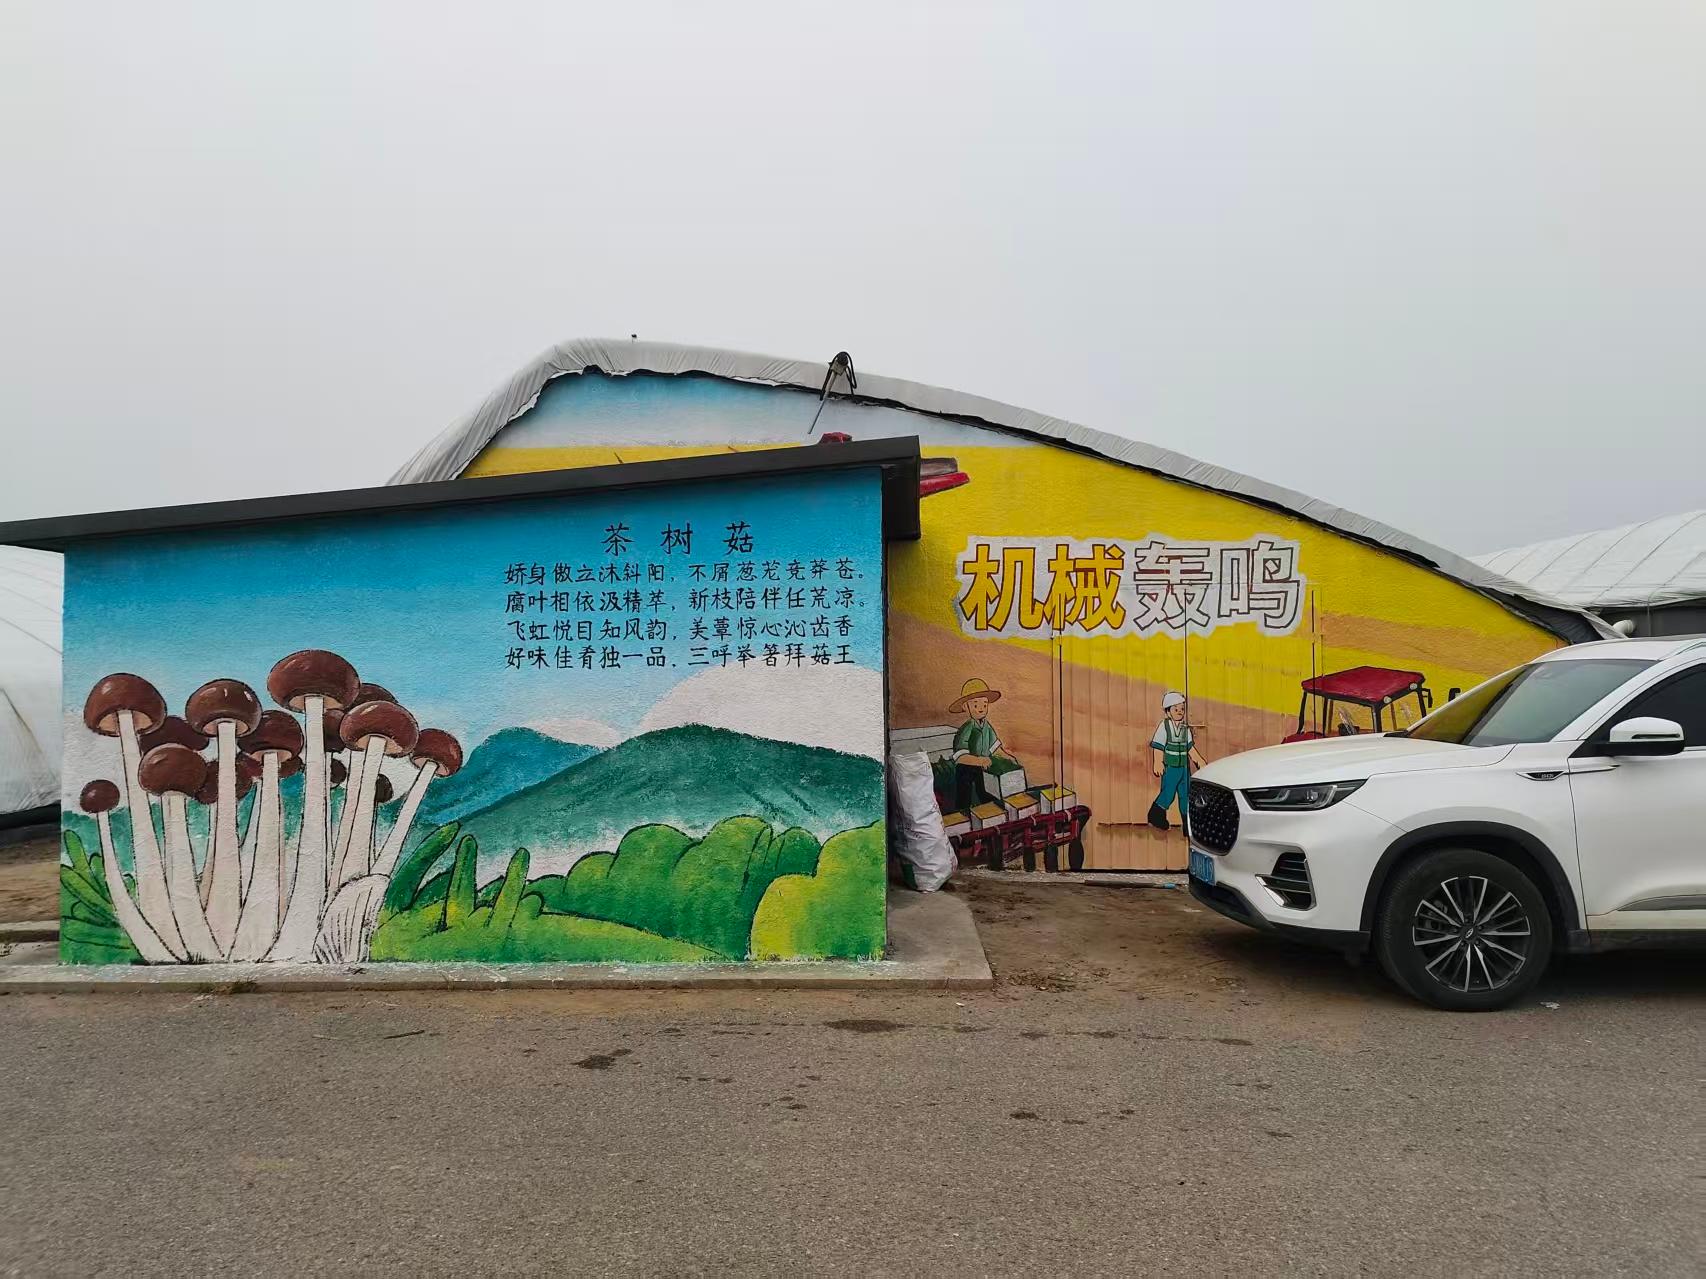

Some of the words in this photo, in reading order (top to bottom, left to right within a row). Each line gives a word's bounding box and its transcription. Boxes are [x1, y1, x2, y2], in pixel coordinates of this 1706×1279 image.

[601, 521, 755, 557] 茶树菇
[958, 540, 1302, 632] 机械轰鸣
